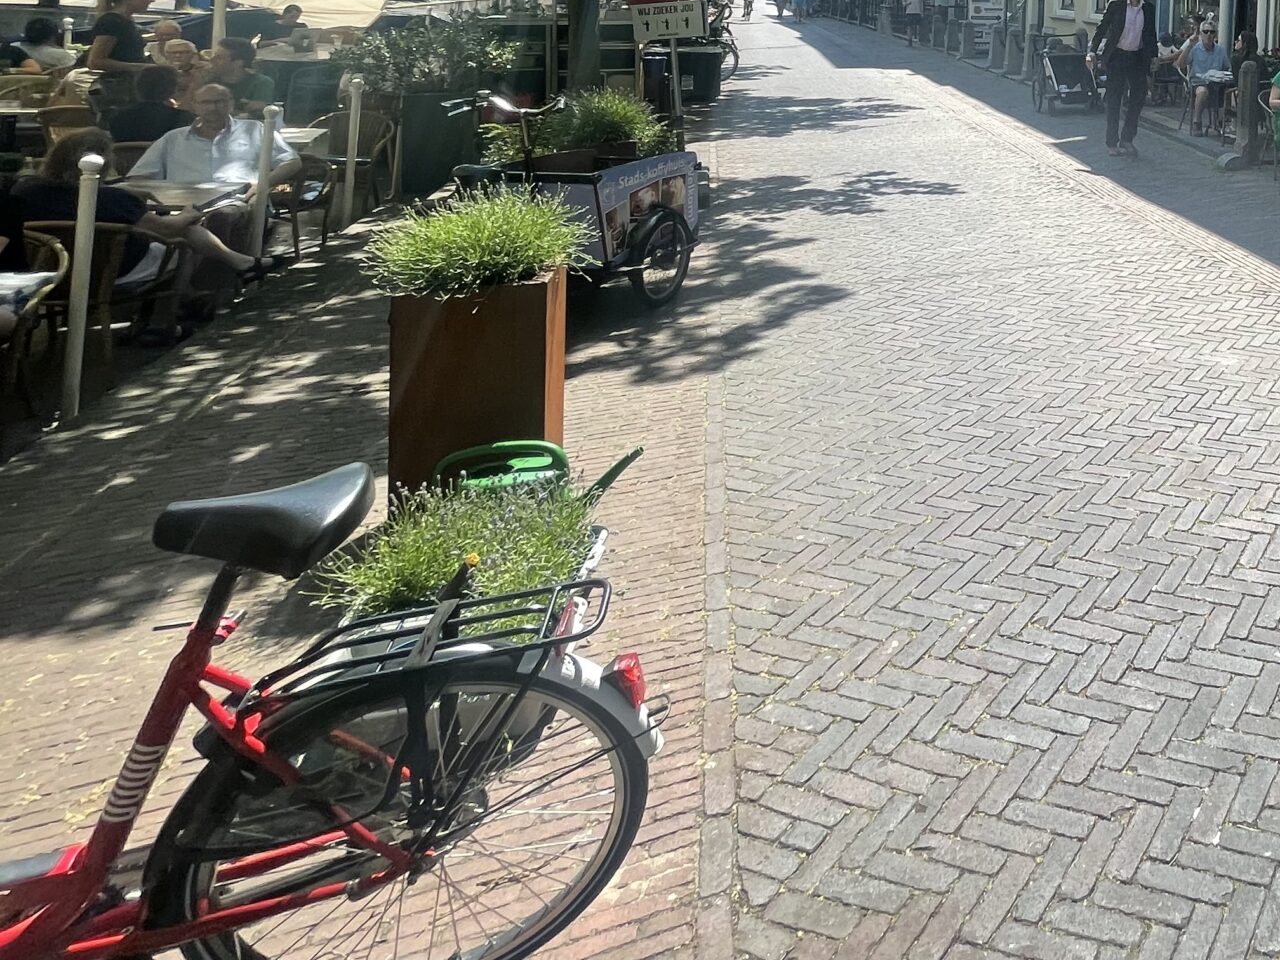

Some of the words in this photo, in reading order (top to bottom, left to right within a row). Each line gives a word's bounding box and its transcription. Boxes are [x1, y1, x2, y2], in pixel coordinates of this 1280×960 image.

[637, 7, 651, 16] WIJ
[652, 5, 678, 15] ZOEKEN
[680, 3, 694, 13] JOU
